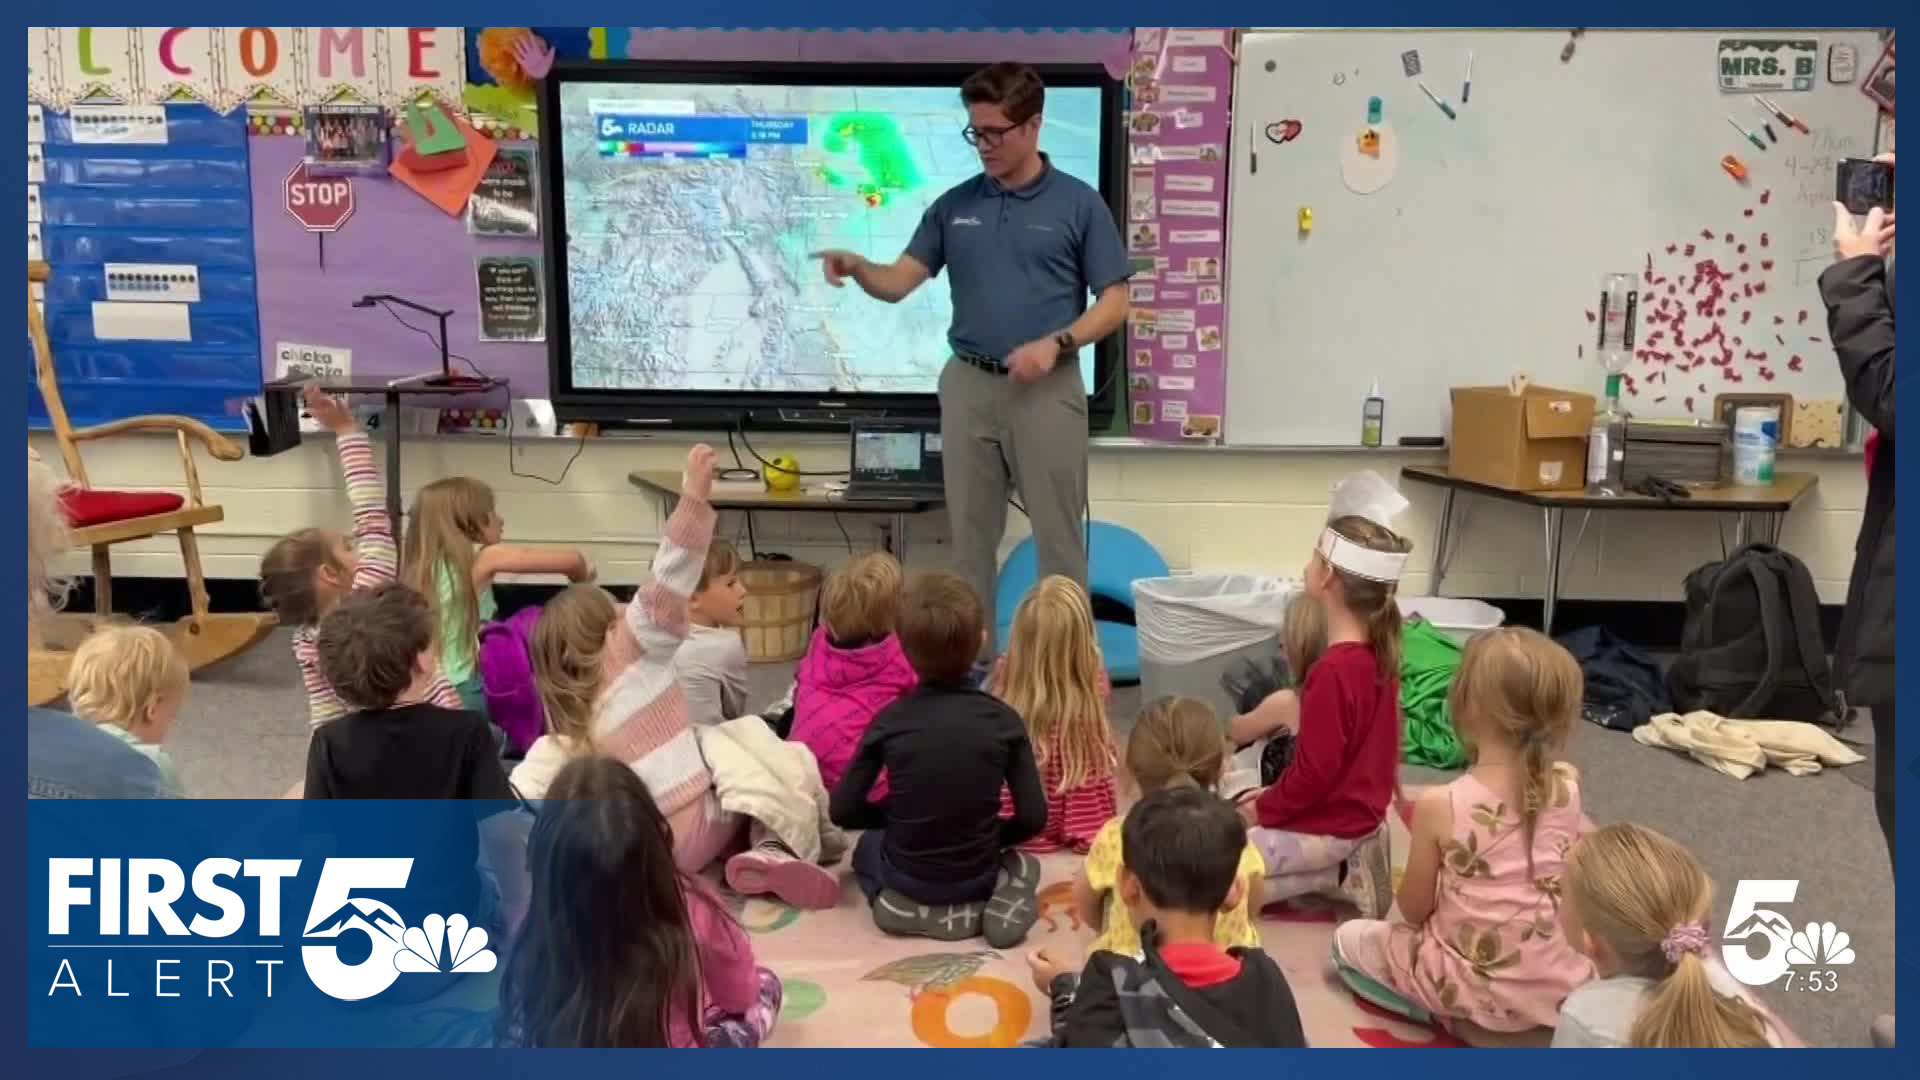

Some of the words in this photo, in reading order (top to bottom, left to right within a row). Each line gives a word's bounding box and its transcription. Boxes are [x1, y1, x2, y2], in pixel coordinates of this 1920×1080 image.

[1721, 57, 1786, 75] MRS.
[1795, 57, 1813, 75] B
[628, 123, 674, 135] RADAR
[290, 183, 348, 206] STOP
[366, 413, 379, 430] 4
